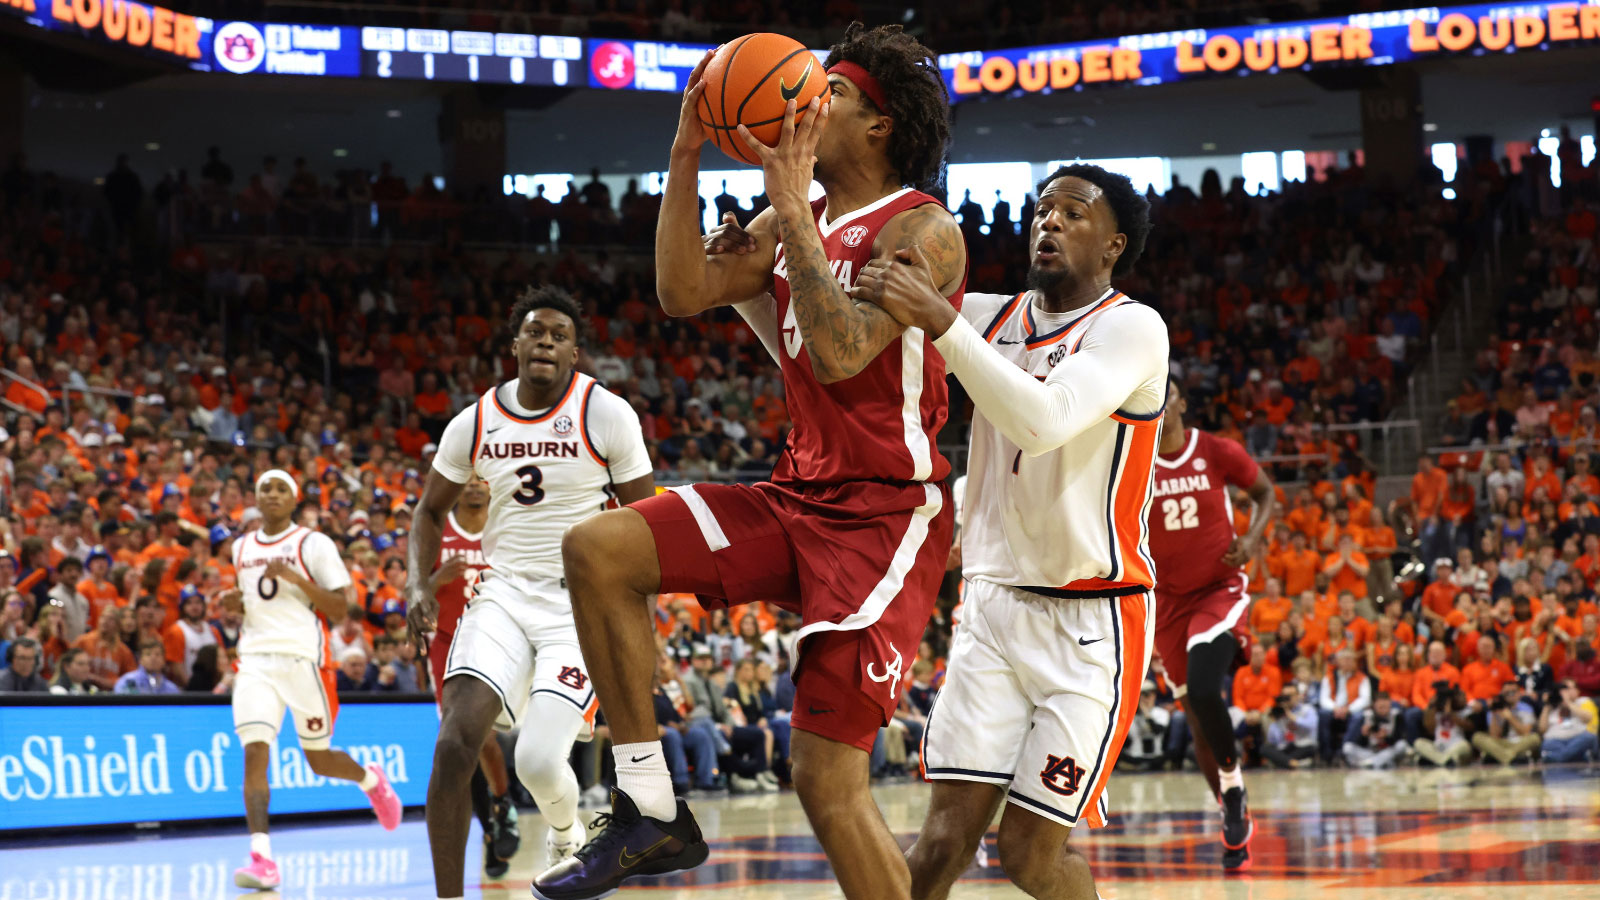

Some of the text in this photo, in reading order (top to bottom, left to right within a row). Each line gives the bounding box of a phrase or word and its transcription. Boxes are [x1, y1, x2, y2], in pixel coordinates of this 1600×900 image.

[376, 50, 393, 78] 2
[423, 52, 435, 80] 1
[468, 54, 480, 82] 1
[953, 46, 1142, 94] LOUDER
[1176, 24, 1374, 72] LOUDER
[1408, 3, 1600, 52] LOUDER
[479, 441, 580, 460] AUBURN
[512, 464, 545, 506] 3
[1154, 474, 1211, 497] LABAMA
[1162, 496, 1200, 531] 22
[185, 732, 231, 793] of
[239, 736, 409, 789] lama
